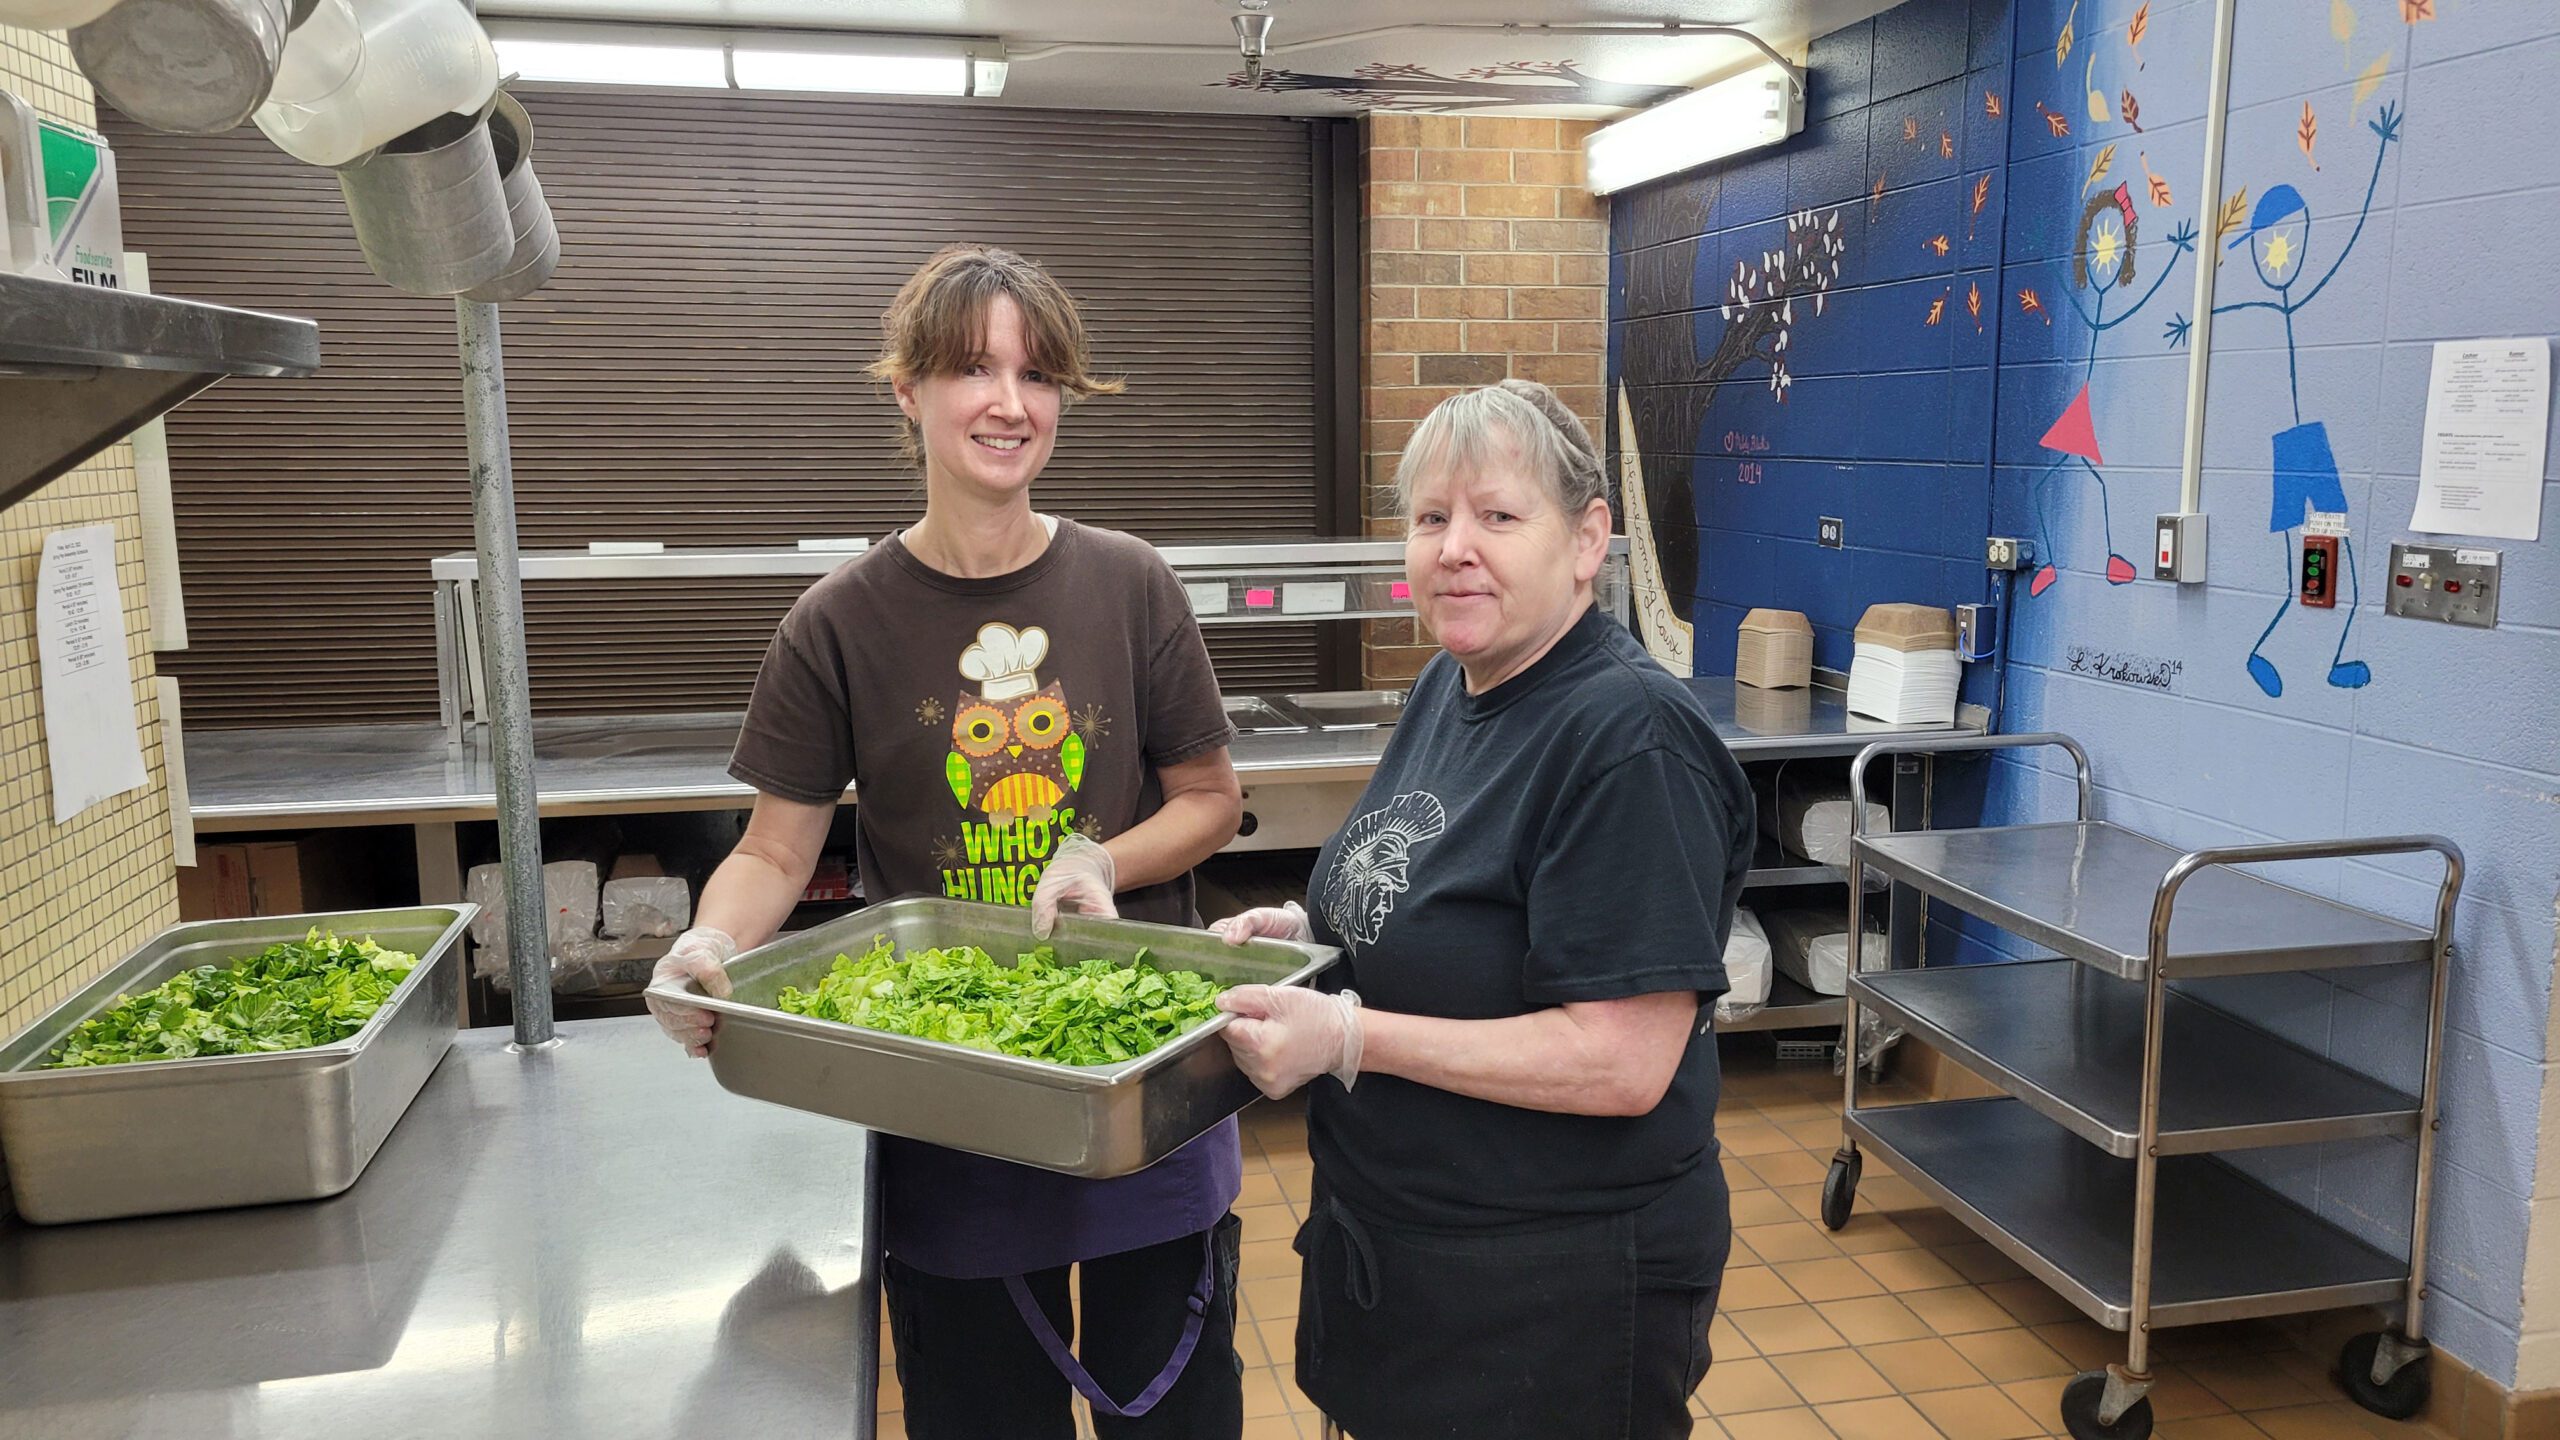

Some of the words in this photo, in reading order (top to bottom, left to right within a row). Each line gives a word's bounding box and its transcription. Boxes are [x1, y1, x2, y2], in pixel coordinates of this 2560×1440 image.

[75, 244, 113, 269] Foodservice
[72, 267, 118, 290] FILM
[1738, 462, 1762, 484] 2014
[960, 807, 1076, 865] WHO'S
[942, 859, 1053, 908] HUNG
